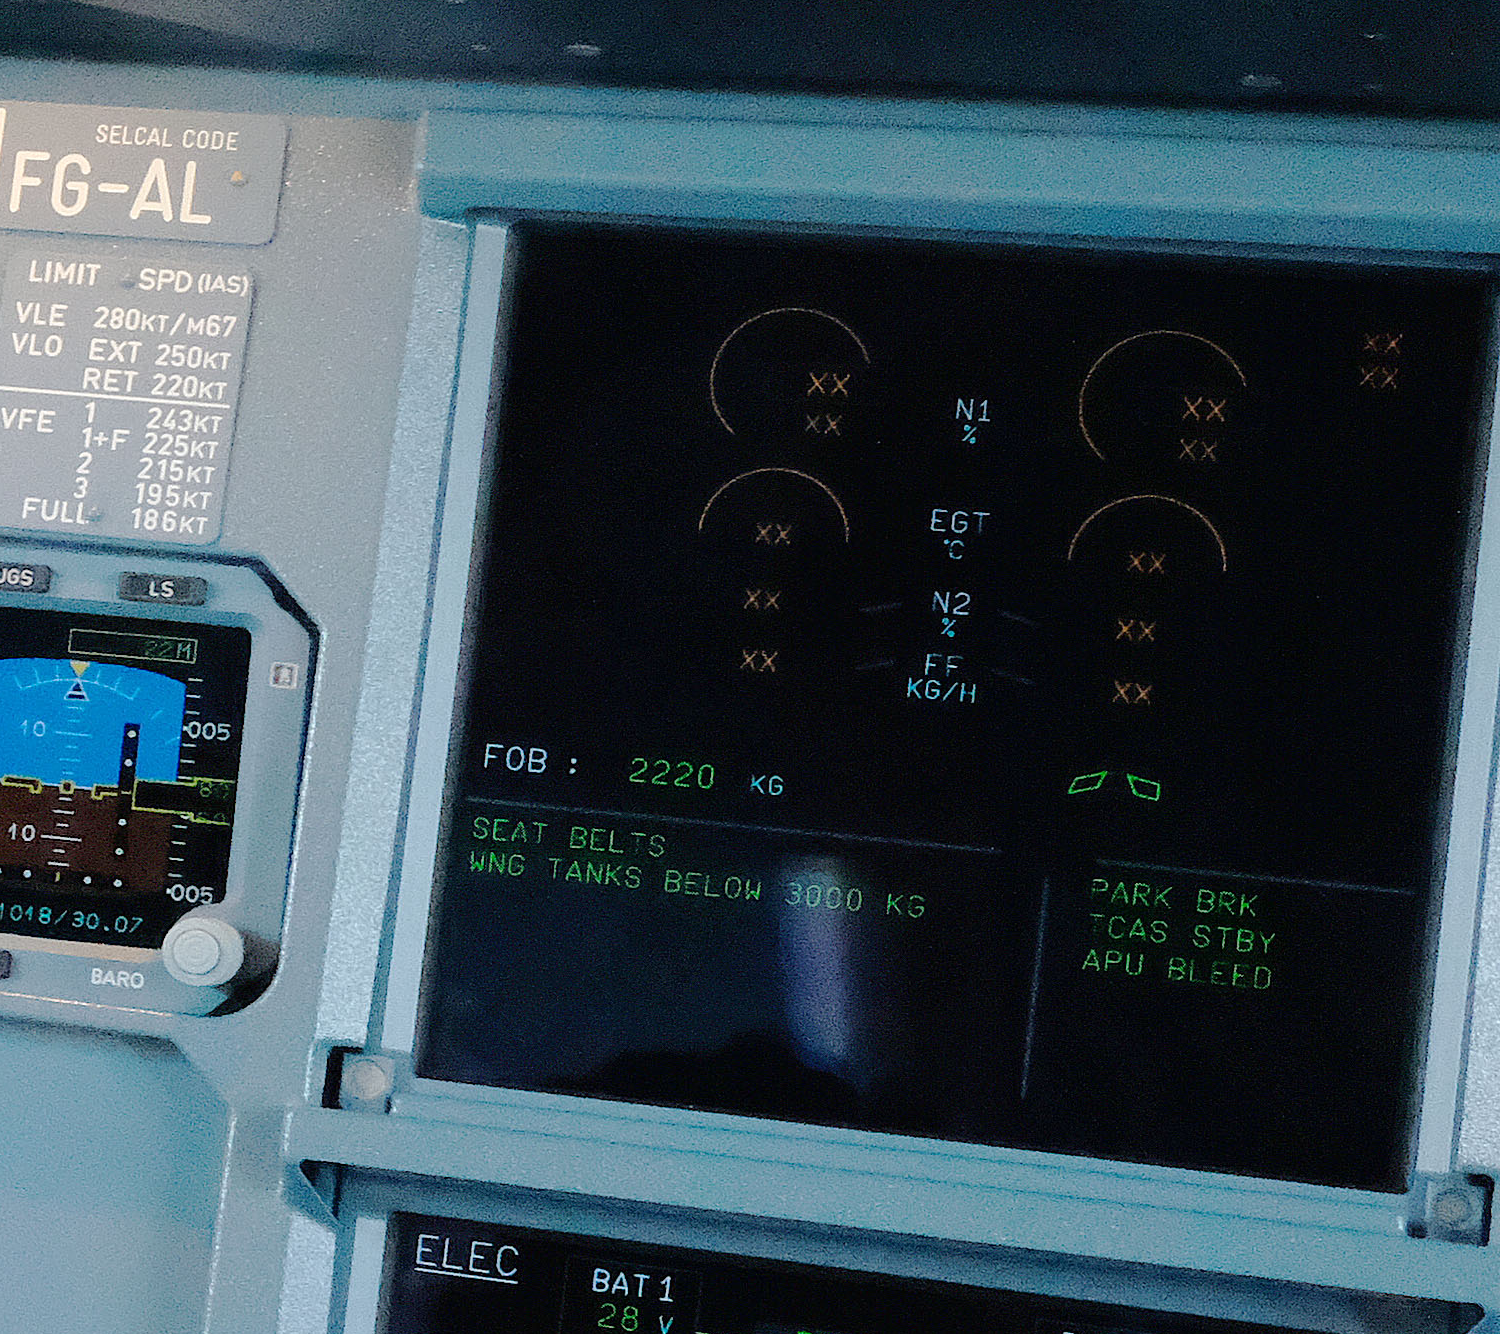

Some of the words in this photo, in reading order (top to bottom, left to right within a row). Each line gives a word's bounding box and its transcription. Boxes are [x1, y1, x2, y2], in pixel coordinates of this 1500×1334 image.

[96, 124, 171, 148] SELCAL
[182, 129, 239, 151] CODE
[9, 150, 212, 224] FG-AL
[28, 259, 101, 287] LIMIT
[138, 268, 194, 294] SPD
[16, 302, 67, 327] VLE
[12, 332, 63, 357] VLO
[88, 338, 142, 364] EXT
[156, 343, 231, 371] 250KT
[82, 368, 136, 394] RET
[151, 373, 227, 401] 220KT
[1, 407, 56, 434] VFE
[83, 402, 95, 423] 1
[146, 407, 223, 435] 243KT
[955, 398, 990, 424] N1
[82, 426, 130, 452] 1+F
[141, 432, 219, 459] 225KT
[22, 498, 88, 525] FULL
[131, 507, 208, 535] 186KT
[907, 679, 976, 704] KG/H
[484, 744, 548, 775] FOB
[629, 758, 715, 791] 2220
[750, 775, 783, 796] KG
[472, 817, 550, 844] SEAT
[569, 826, 665, 857] BELTS
[470, 850, 526, 879] WNG
[548, 859, 642, 889] TANKS
[665, 870, 761, 901] BELOW
[784, 882, 863, 913] 3000
[886, 891, 926, 920] KG
[1092, 878, 1172, 909] PARK
[1195, 887, 1258, 918] BRK
[1090, 913, 1172, 944] TCAS
[1193, 924, 1276, 956] STBY
[1082, 948, 1143, 978] APU
[1168, 958, 1272, 990] BLEED
[416, 1234, 519, 1274] ELEC
